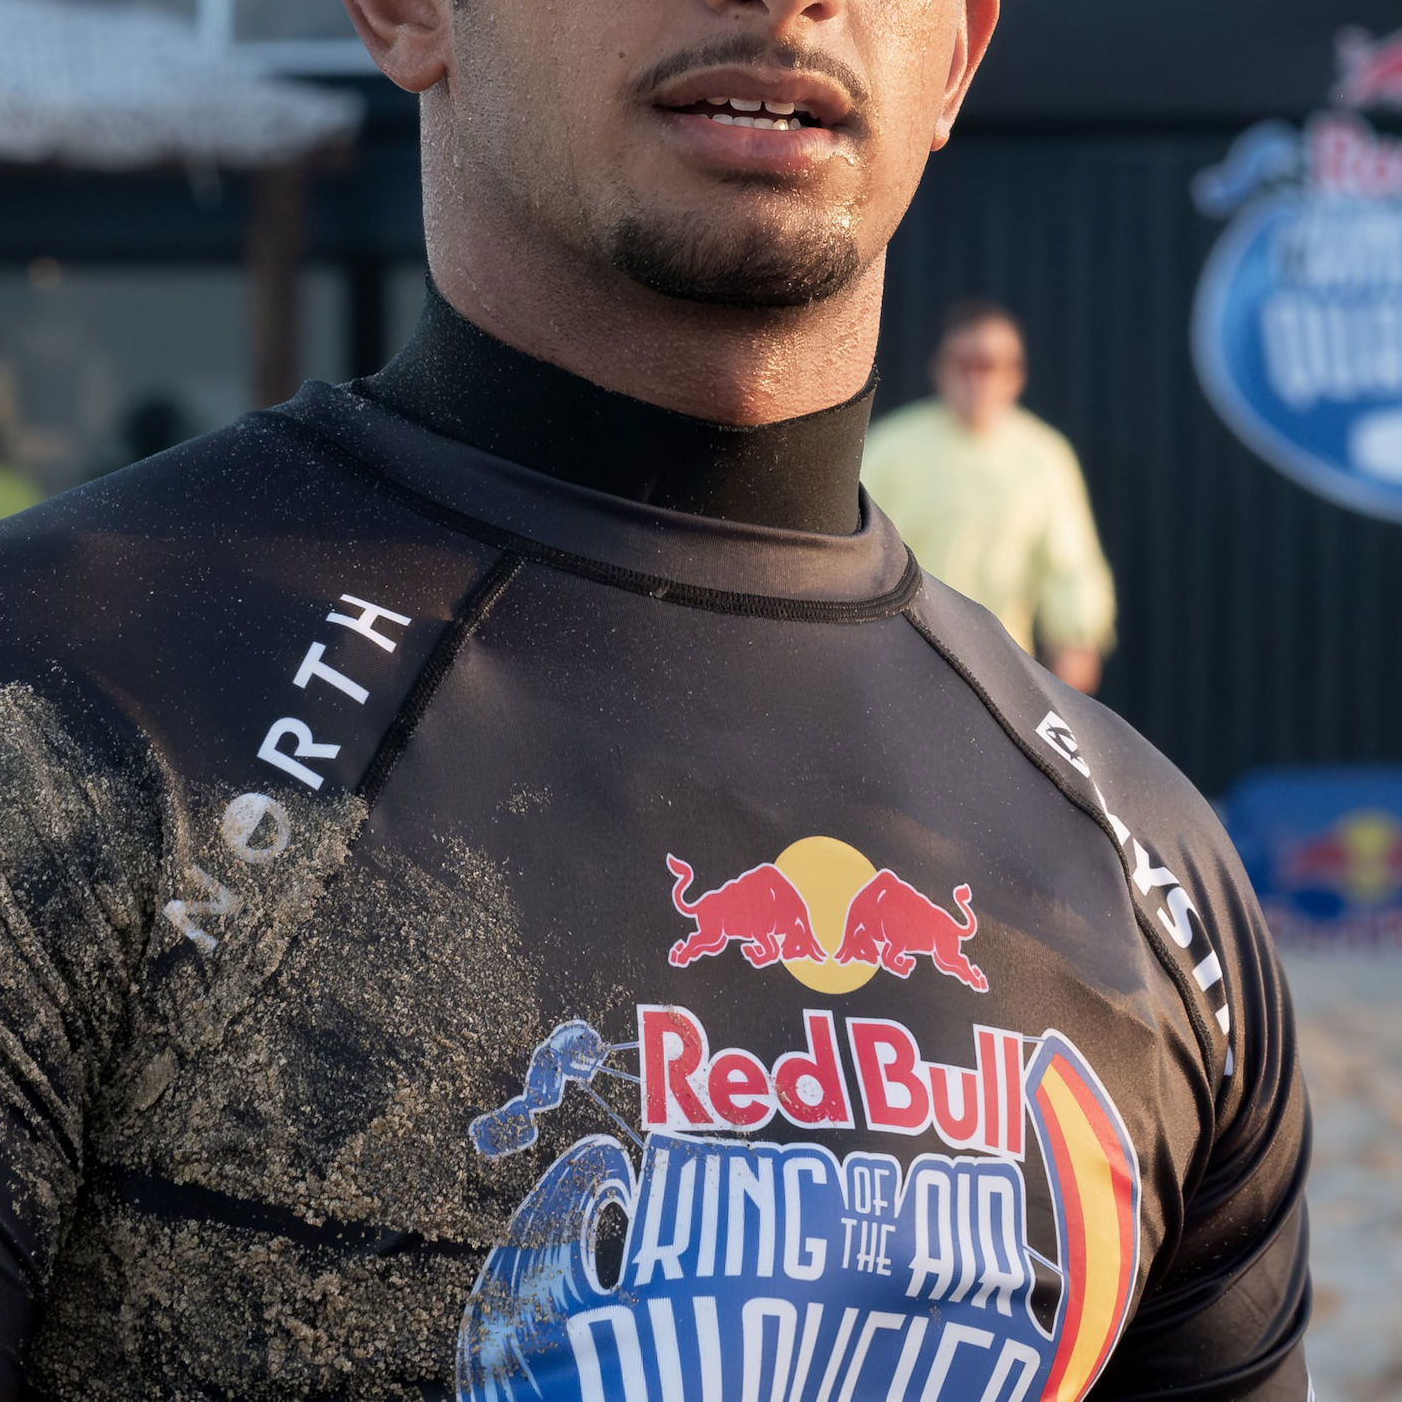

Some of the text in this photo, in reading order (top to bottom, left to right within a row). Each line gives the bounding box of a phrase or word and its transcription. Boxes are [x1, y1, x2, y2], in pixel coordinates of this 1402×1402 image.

[162, 593, 412, 954] NORTH
[640, 1007, 1022, 1156] Red Bull
[632, 1148, 1025, 1318] KING OF THE AIR
